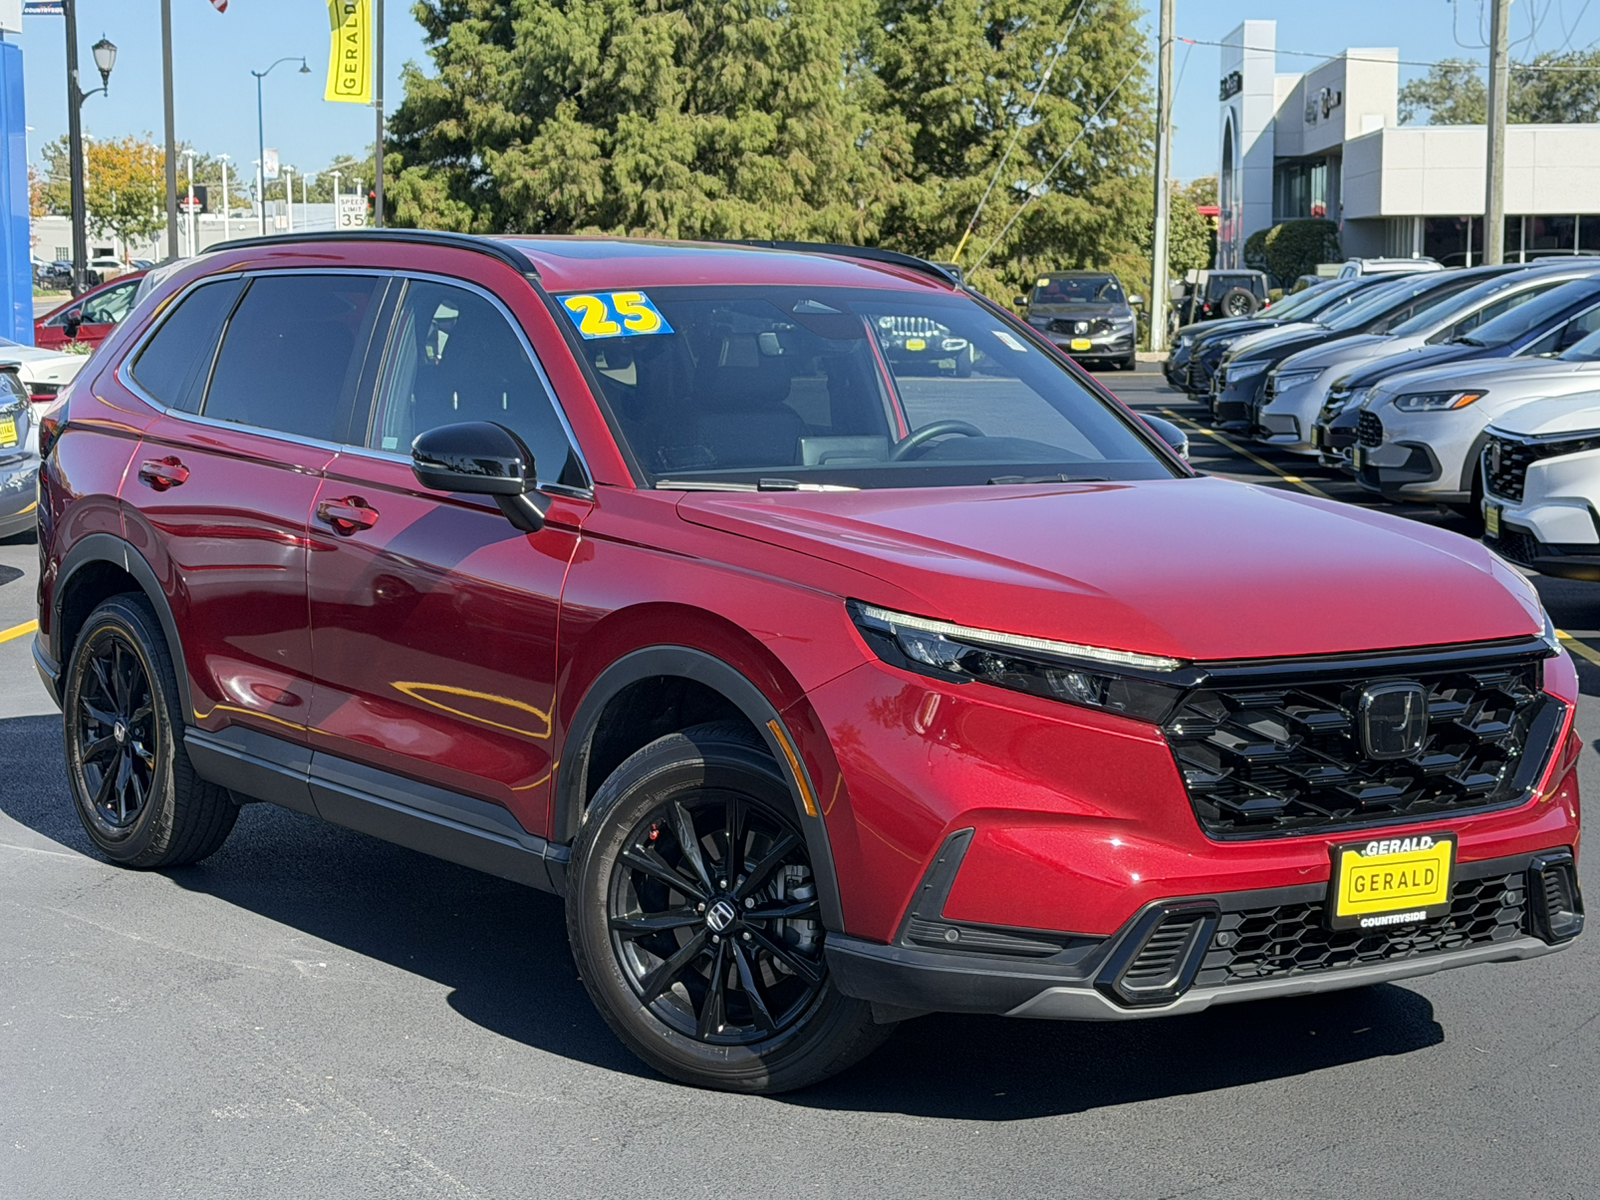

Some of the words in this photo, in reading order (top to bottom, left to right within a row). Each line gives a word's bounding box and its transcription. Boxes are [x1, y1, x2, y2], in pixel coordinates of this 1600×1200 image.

[343, 4, 358, 89] GERALD
[342, 213, 364, 227] 35
[564, 292, 662, 337] 25
[1365, 836, 1433, 857] GERALD
[1354, 868, 1435, 893] GERALD
[1360, 911, 1427, 928] COUNTRYSIDE
